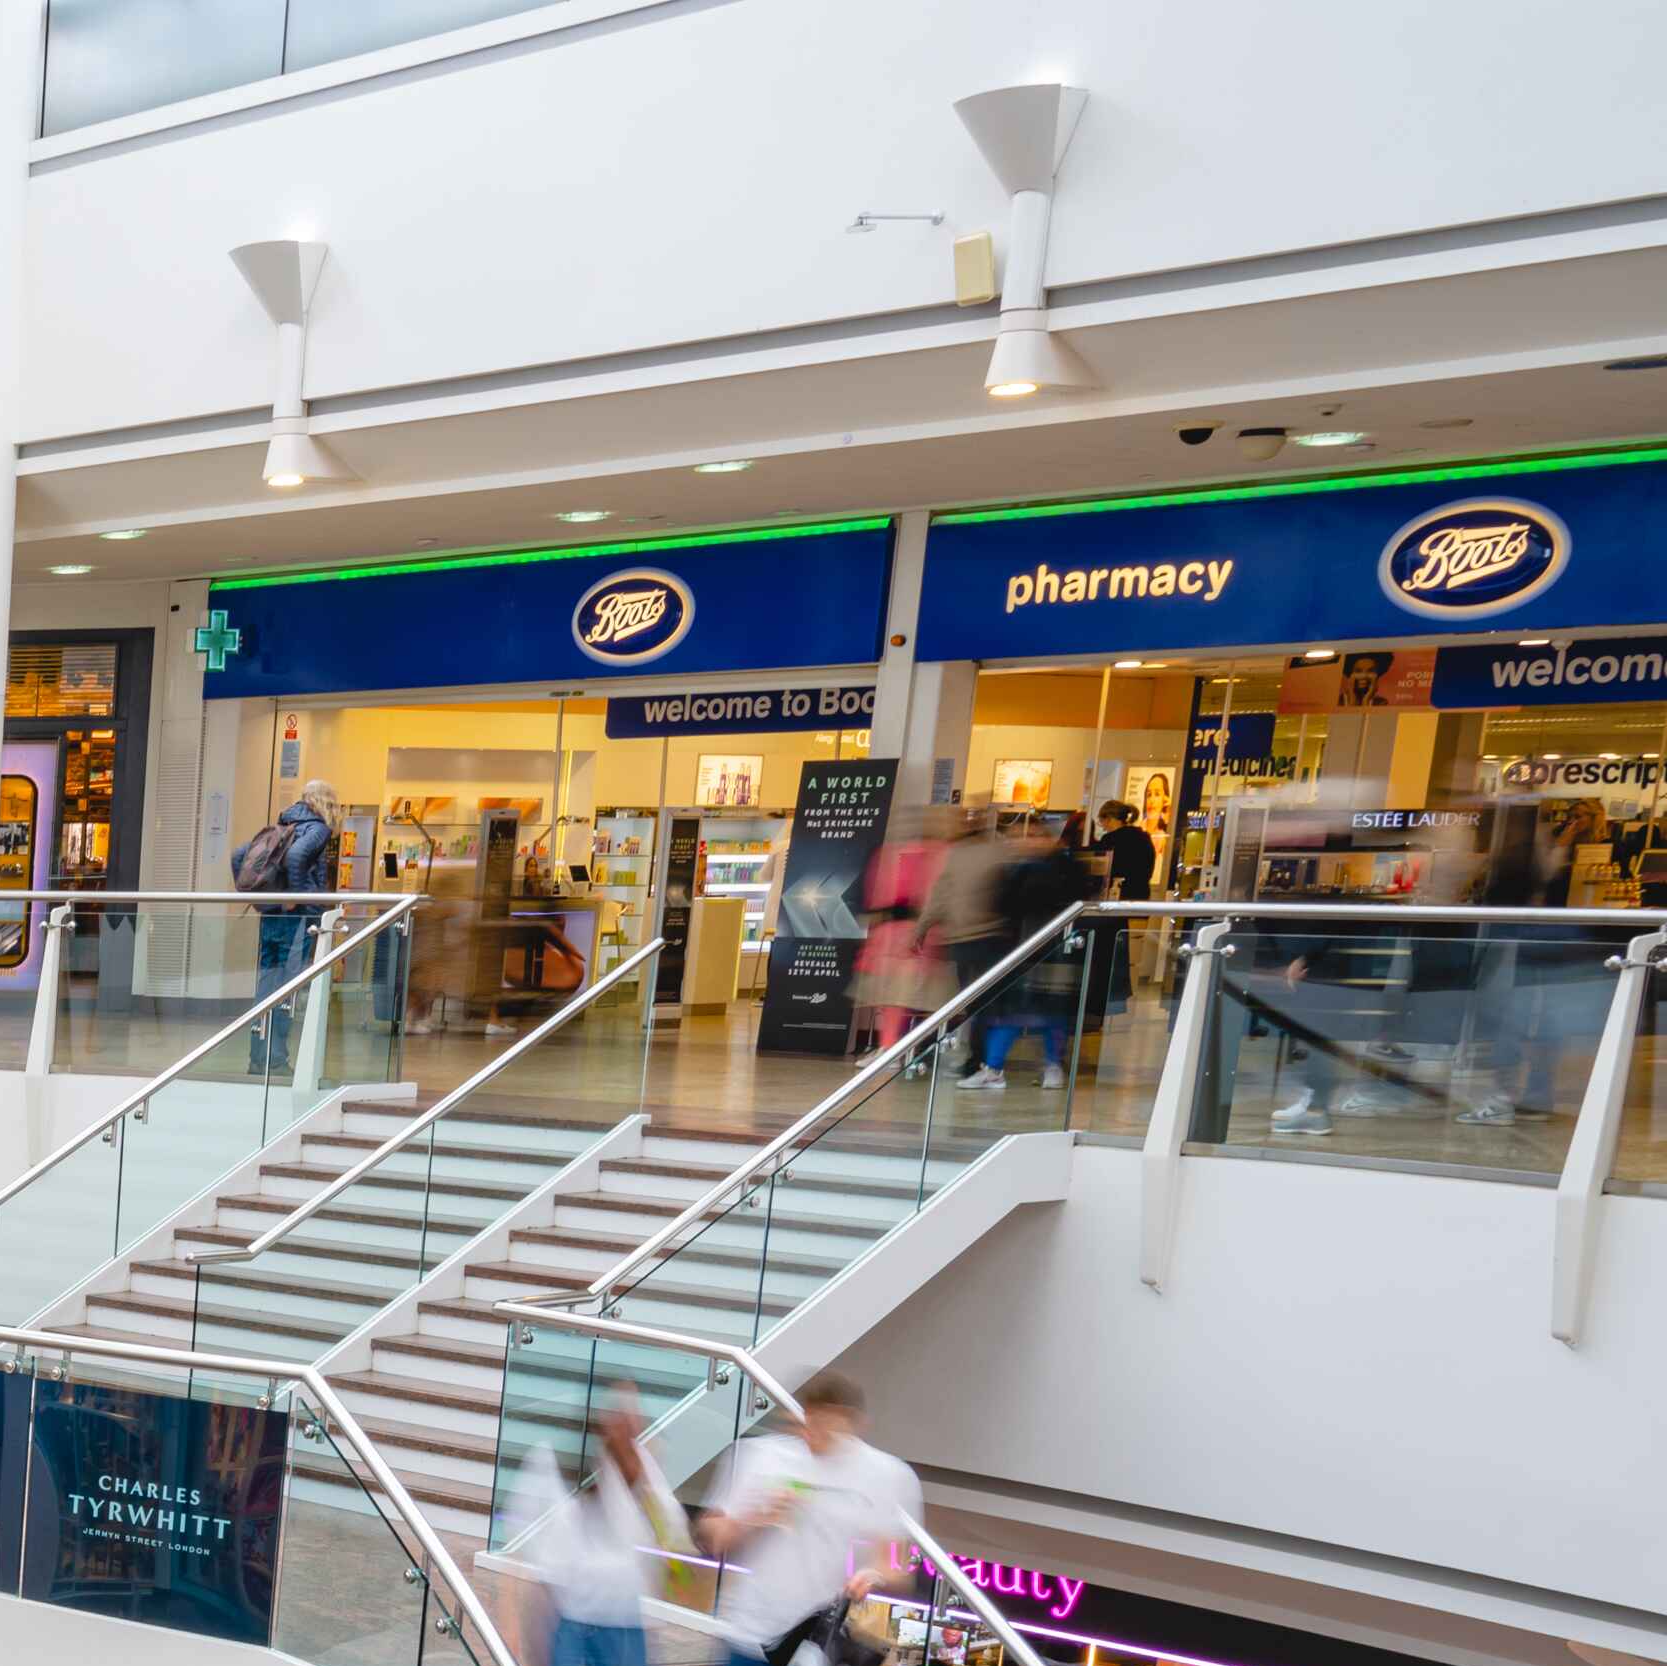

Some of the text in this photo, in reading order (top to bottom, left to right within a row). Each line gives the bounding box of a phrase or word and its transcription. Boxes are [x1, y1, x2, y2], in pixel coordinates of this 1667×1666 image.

[1402, 522, 1531, 592] Boots
[1005, 559, 1233, 613] pharmacy
[584, 588, 667, 645] Boots
[1492, 649, 1667, 688] welcom
[644, 687, 875, 723] welcome to Boo
[1194, 727, 1230, 747] ere
[808, 776, 888, 789] A WORLD
[820, 792, 870, 804] FIRST
[804, 808, 880, 817] FROM THE UK'S
[825, 819, 874, 828] SKINCARE
[1408, 811, 1480, 827] LAUDER
[788, 968, 840, 977] 12TH APRIL
[794, 960, 837, 968] REVEALED
[98, 1475, 201, 1506] CHARLES
[68, 1494, 231, 1539] TYRWHITT
[82, 1526, 210, 1556] JERMYN STREET LONDON
